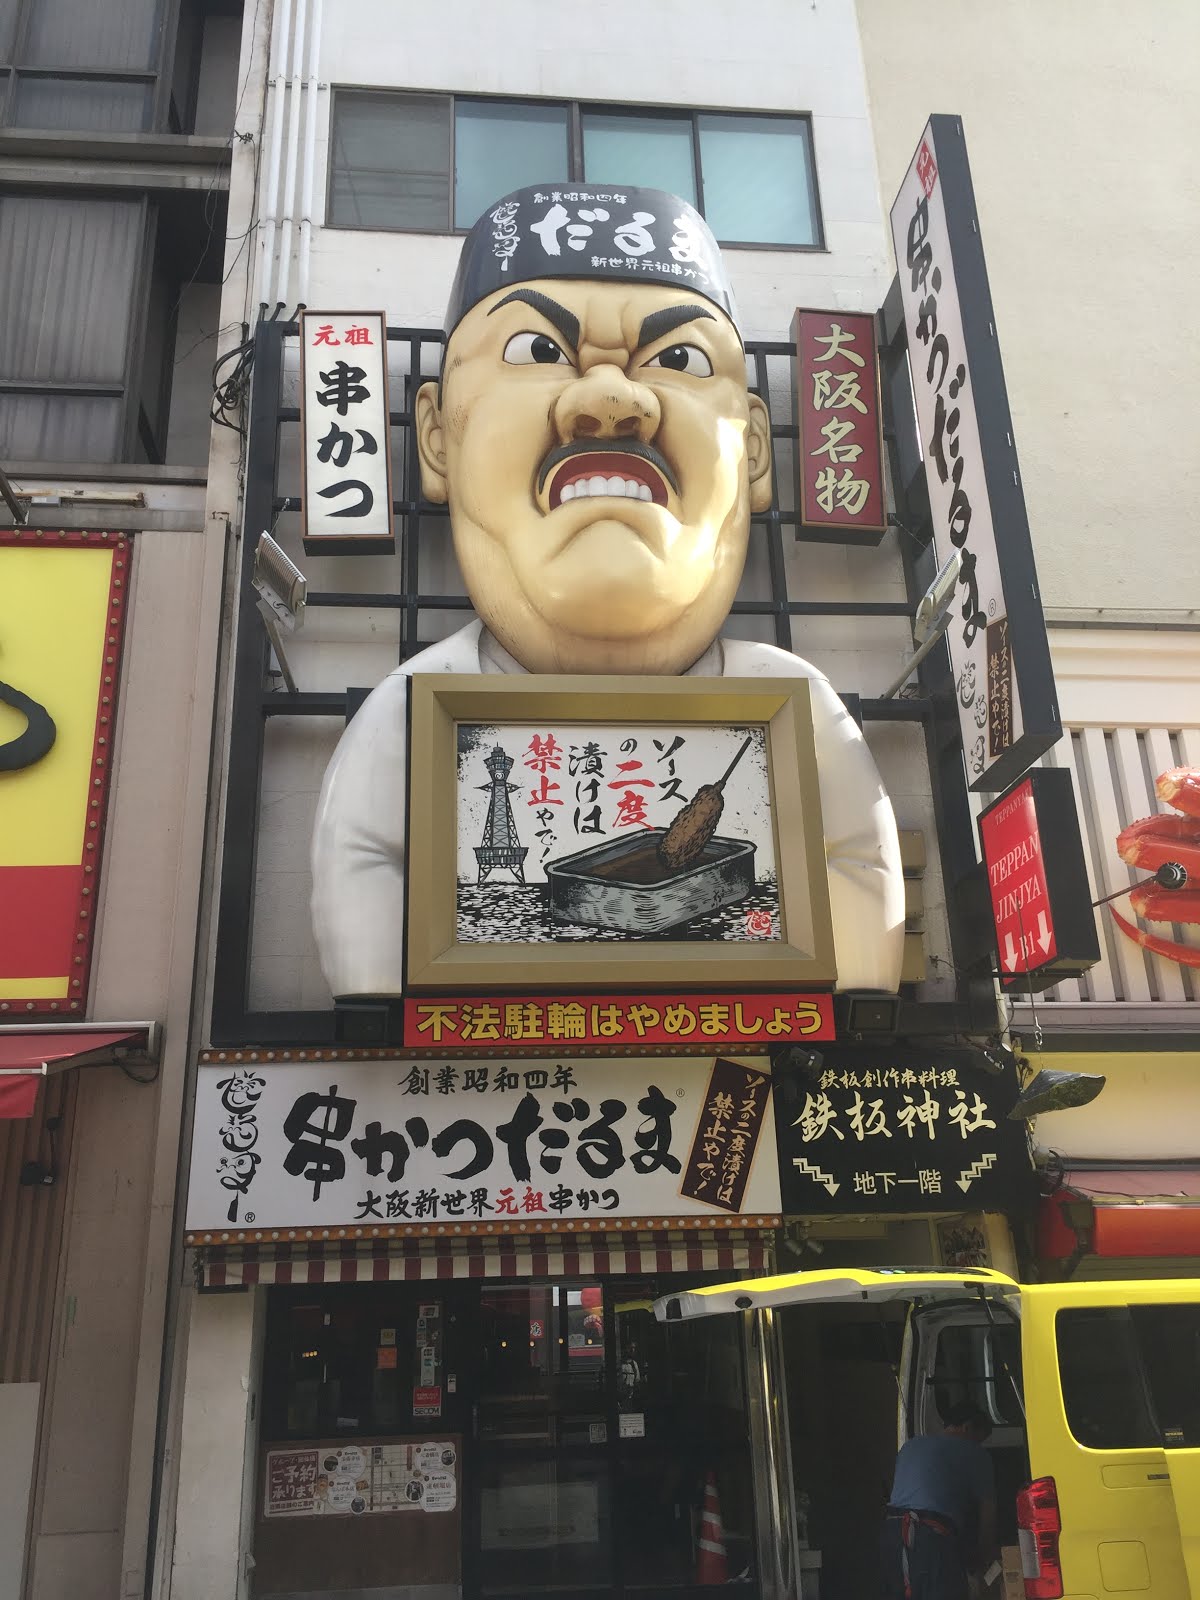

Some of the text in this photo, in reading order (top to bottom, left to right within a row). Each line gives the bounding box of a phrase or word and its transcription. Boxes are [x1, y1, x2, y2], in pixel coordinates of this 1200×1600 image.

[534, 192, 628, 205] 創業昭和四年
[530, 203, 710, 271] だるま
[591, 255, 710, 285] 新世界元祖串かつ
[312, 324, 374, 346] 元祖
[315, 360, 378, 518] 串かつ
[810, 323, 870, 515] 大阪名物
[906, 196, 987, 650] 串かつだるま
[568, 741, 608, 835] 漬けは
[607, 737, 656, 831] の二度
[653, 735, 688, 803] ソース
[521, 733, 564, 864] 禁止やで！
[994, 785, 1032, 826] TEPPANYAKI
[990, 831, 1040, 887] TEPPAN
[996, 874, 1042, 924] JINJYA
[1019, 932, 1036, 961] B1
[416, 1001, 823, 1041] 不法駐輪はやめましょう
[398, 1064, 578, 1096] 創業昭和四年
[817, 1066, 960, 1090] 鉄板創作串料理
[717, 1073, 766, 1205] ソースの二度漬けは
[790, 1089, 997, 1143] 鉄板神社
[283, 1084, 682, 1202] 串かつだるま
[694, 1092, 735, 1196] 禁止やで！
[353, 1184, 620, 1220] 大阪新世界元祖串かつ
[853, 1169, 942, 1195] 地下一階
[414, 1407, 440, 1415] SECOM
[272, 1464, 317, 1484] ご予約
